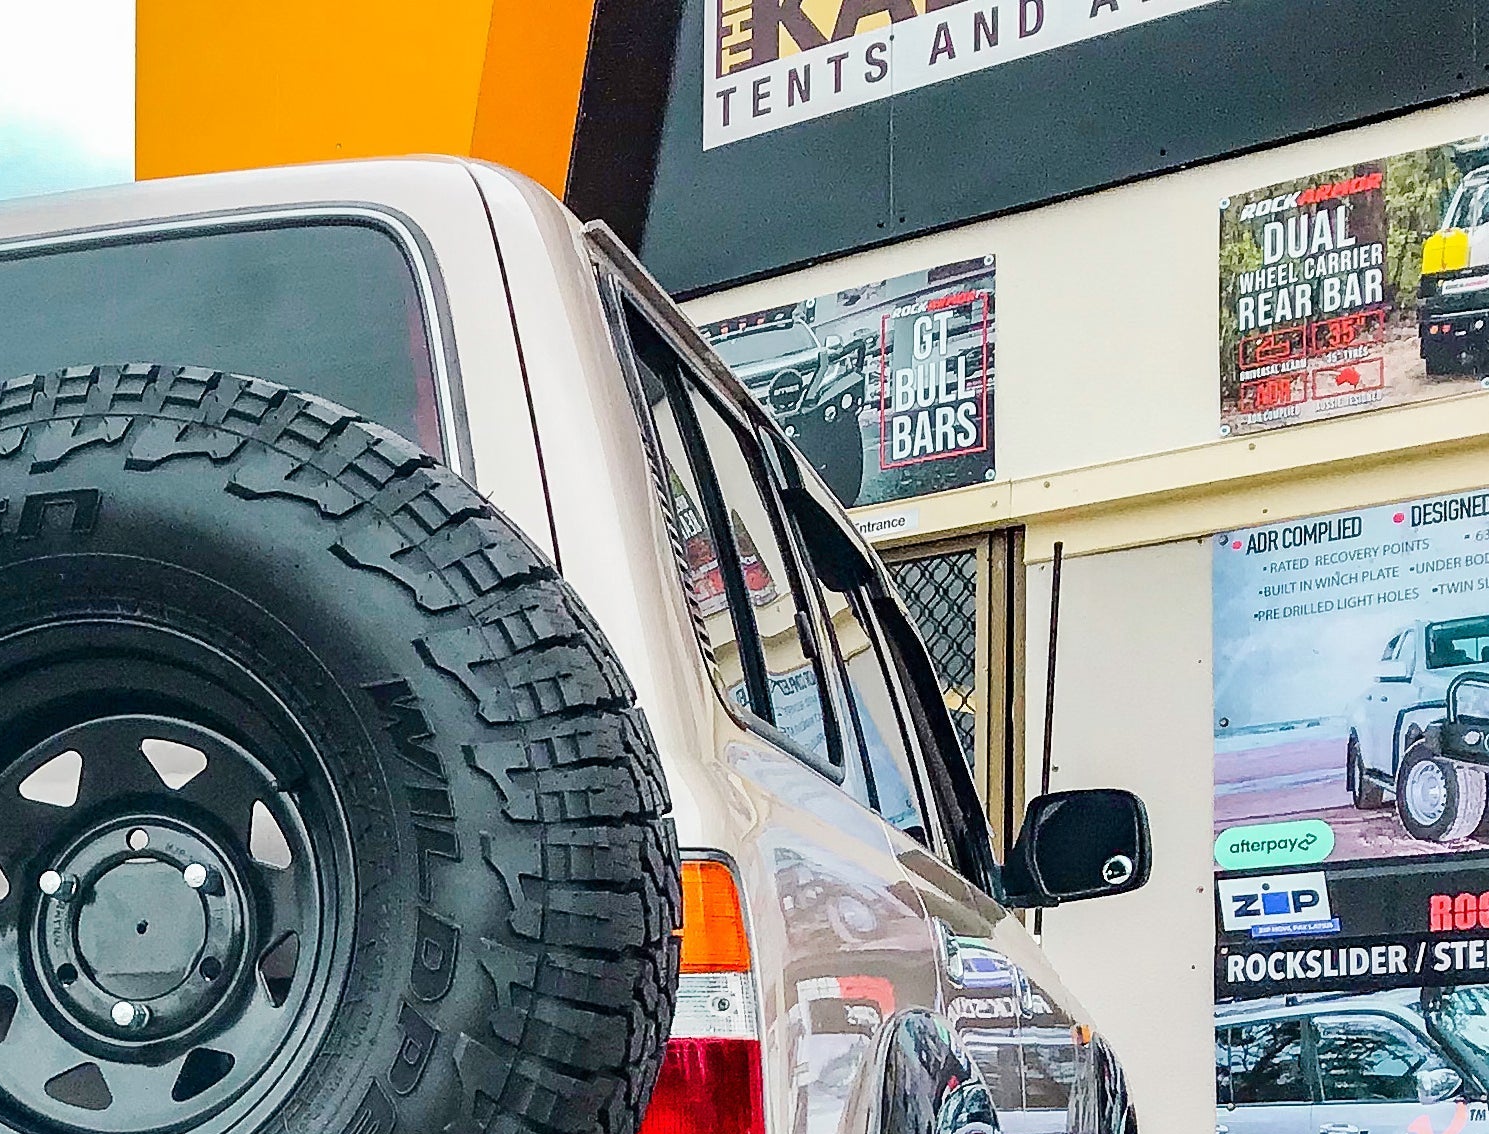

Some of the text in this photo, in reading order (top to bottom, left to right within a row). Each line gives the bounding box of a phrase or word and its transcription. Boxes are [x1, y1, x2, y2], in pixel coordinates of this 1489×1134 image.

[716, 0, 1045, 127] TENTS AND
[1264, 205, 1355, 265] DUAL
[1240, 243, 1383, 294] WHEEL CARRIER
[1238, 268, 1383, 331] REAR BAR
[913, 310, 954, 361] GT
[894, 355, 976, 413] BULL
[892, 402, 977, 460] BARS
[1246, 516, 1362, 555] ADR COMPLIED
[1270, 538, 1430, 573] RATED RECOVERY POINTS
[1264, 566, 1400, 597] BUILT IN WINCH PLATE
[1415, 556, 1462, 574] UNDER
[1258, 587, 1419, 621] PRE DRILLED LIGHT HOLES
[1438, 580, 1473, 595] TWIN
[1230, 838, 1298, 854] afterpay
[1227, 945, 1408, 982] ROCKSLIDER
[1434, 940, 1489, 972] STE
